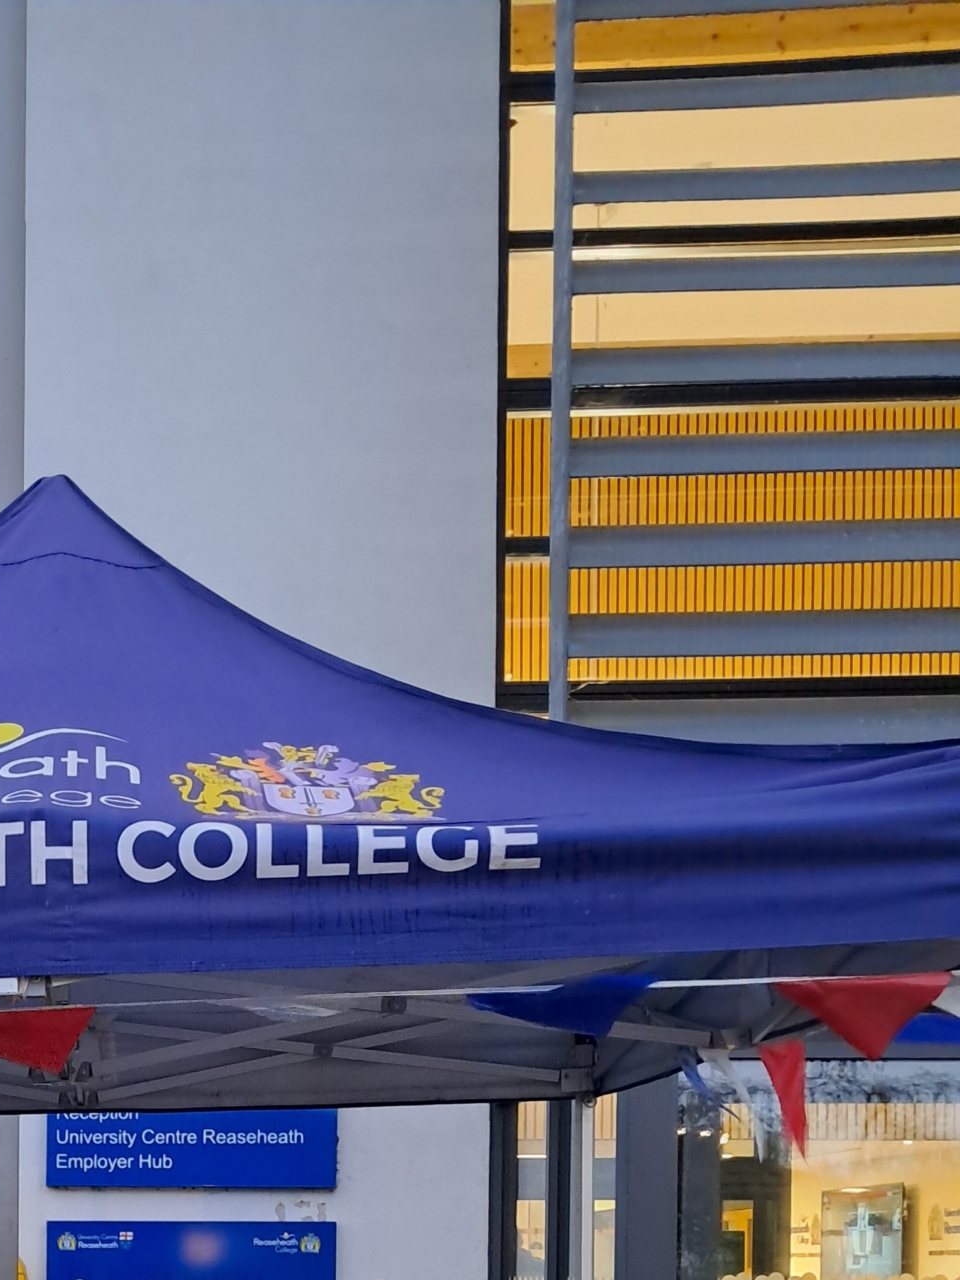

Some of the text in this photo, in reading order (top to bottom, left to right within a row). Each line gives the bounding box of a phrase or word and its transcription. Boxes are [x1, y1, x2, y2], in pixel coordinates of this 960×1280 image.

[117, 820, 541, 883] COLLEGE
[56, 1129, 304, 1148] University Centre Reaseheath
[56, 1153, 173, 1172] Employer Hub
[78, 1240, 119, 1249] Reaseheath
[253, 1237, 299, 1246] Reaseheath
[275, 1246, 298, 1254] College
